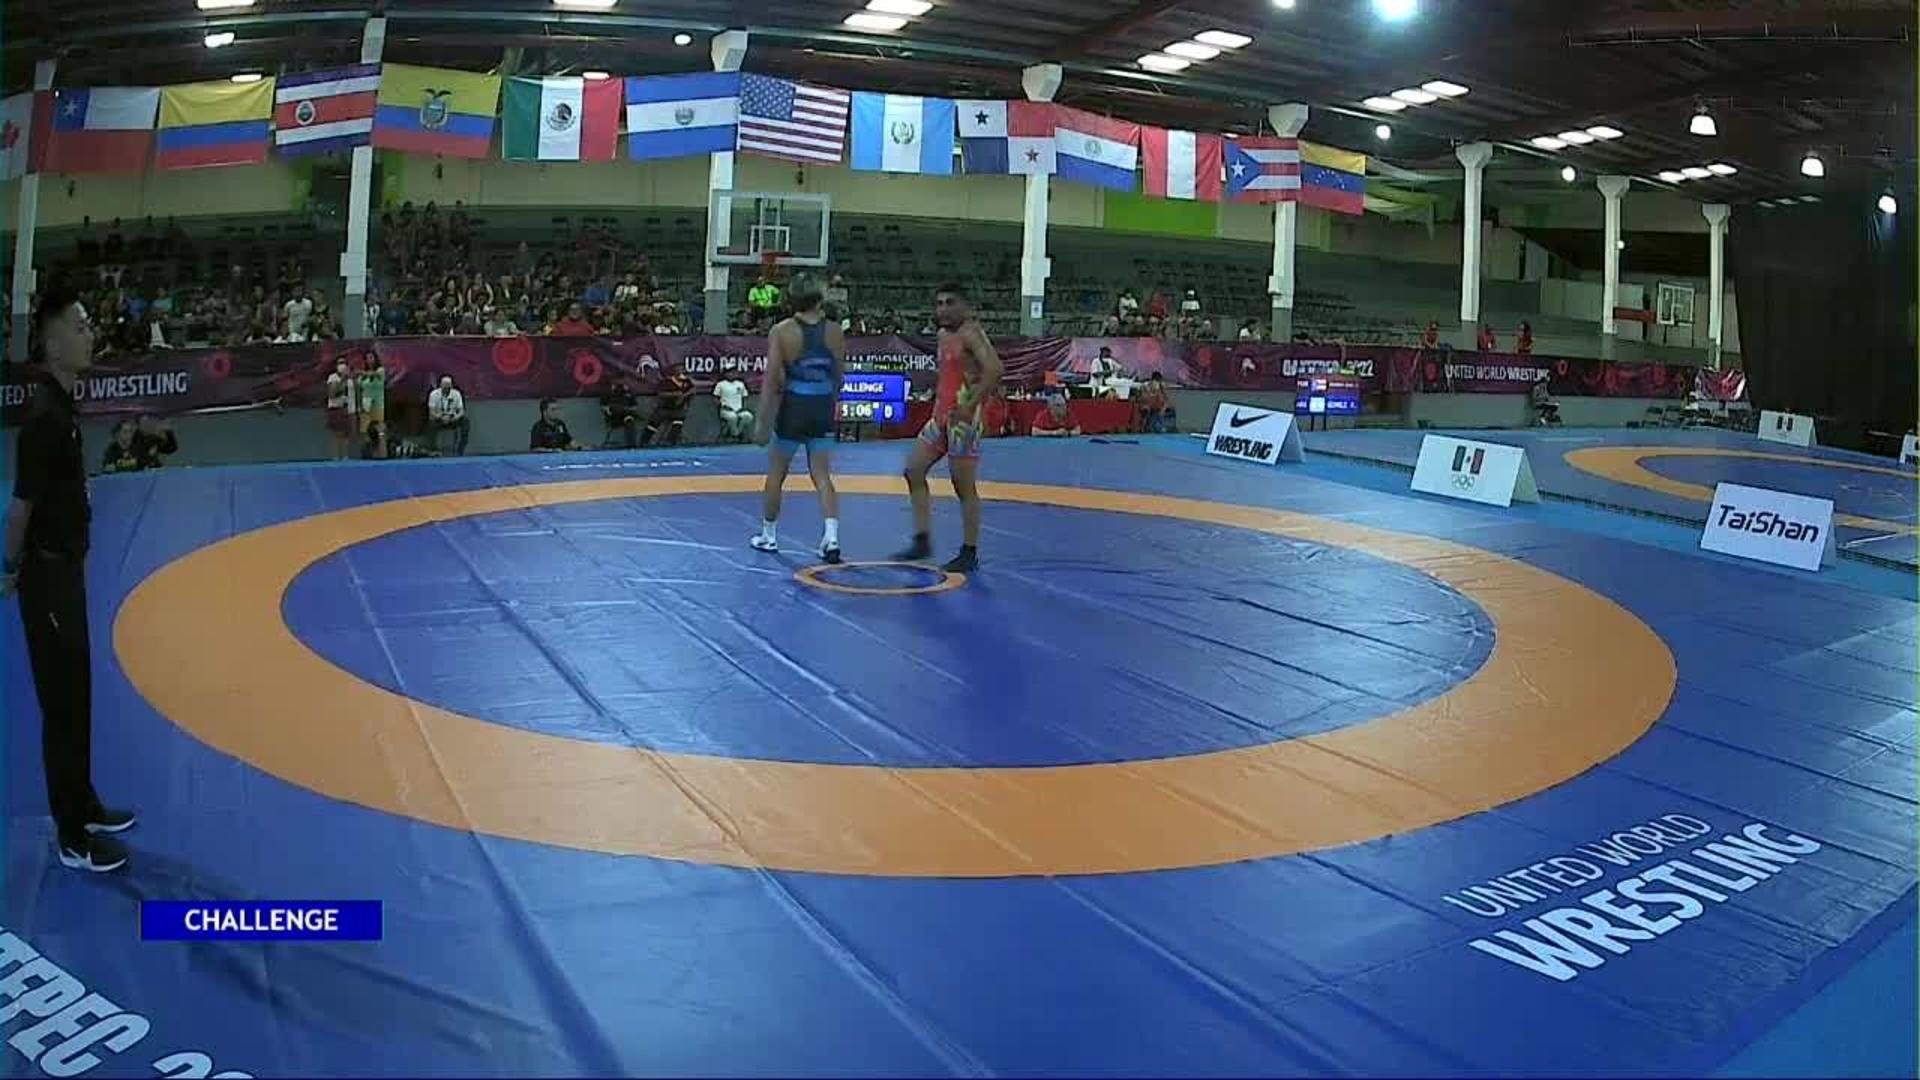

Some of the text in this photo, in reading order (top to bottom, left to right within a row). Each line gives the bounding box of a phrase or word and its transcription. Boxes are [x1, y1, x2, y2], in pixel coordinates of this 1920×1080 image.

[685, 356, 715, 372] U20
[1476, 366, 1506, 380] WORLD
[90, 372, 187, 399] WRESTLING
[1214, 434, 1273, 460] WRESTLING
[1718, 504, 1819, 542] TaiShan
[1442, 813, 1712, 917] UNITED WORLD
[1468, 822, 1822, 982] WRESTLING
